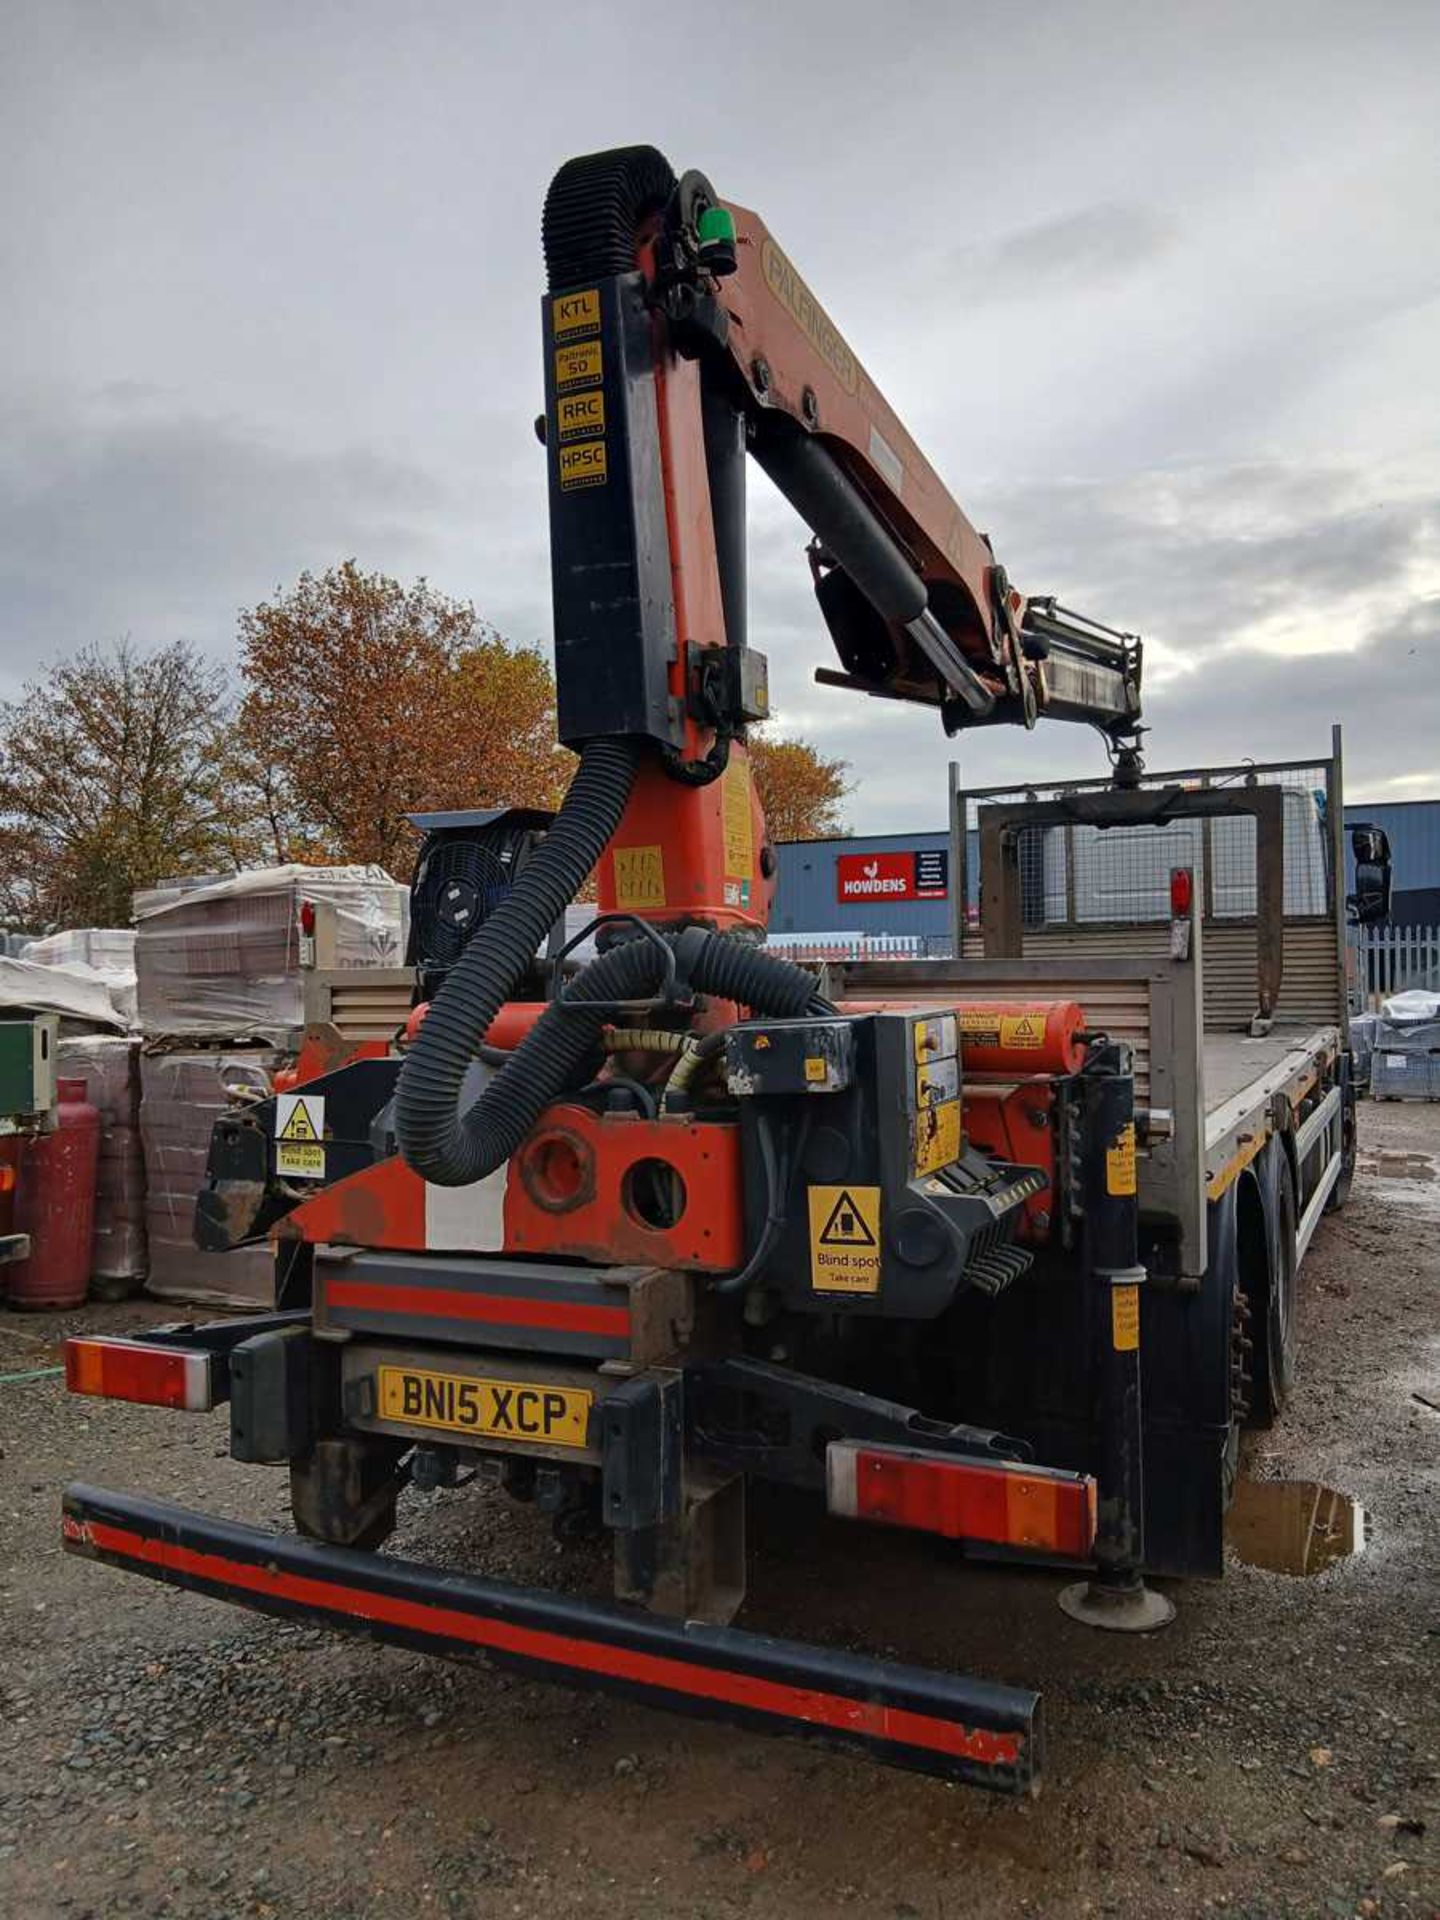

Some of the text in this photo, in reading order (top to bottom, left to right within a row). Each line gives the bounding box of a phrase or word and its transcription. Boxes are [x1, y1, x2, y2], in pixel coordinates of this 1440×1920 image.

[560, 297, 592, 320] KTL
[563, 400, 600, 420] RRC
[562, 447, 603, 469] HPSC
[844, 878, 907, 895] HOWDENS
[281, 1155, 321, 1168] Take care
[818, 1253, 882, 1270] Blind spot
[831, 1272, 849, 1283] Take
[403, 1375, 567, 1435] BN15 XCP
